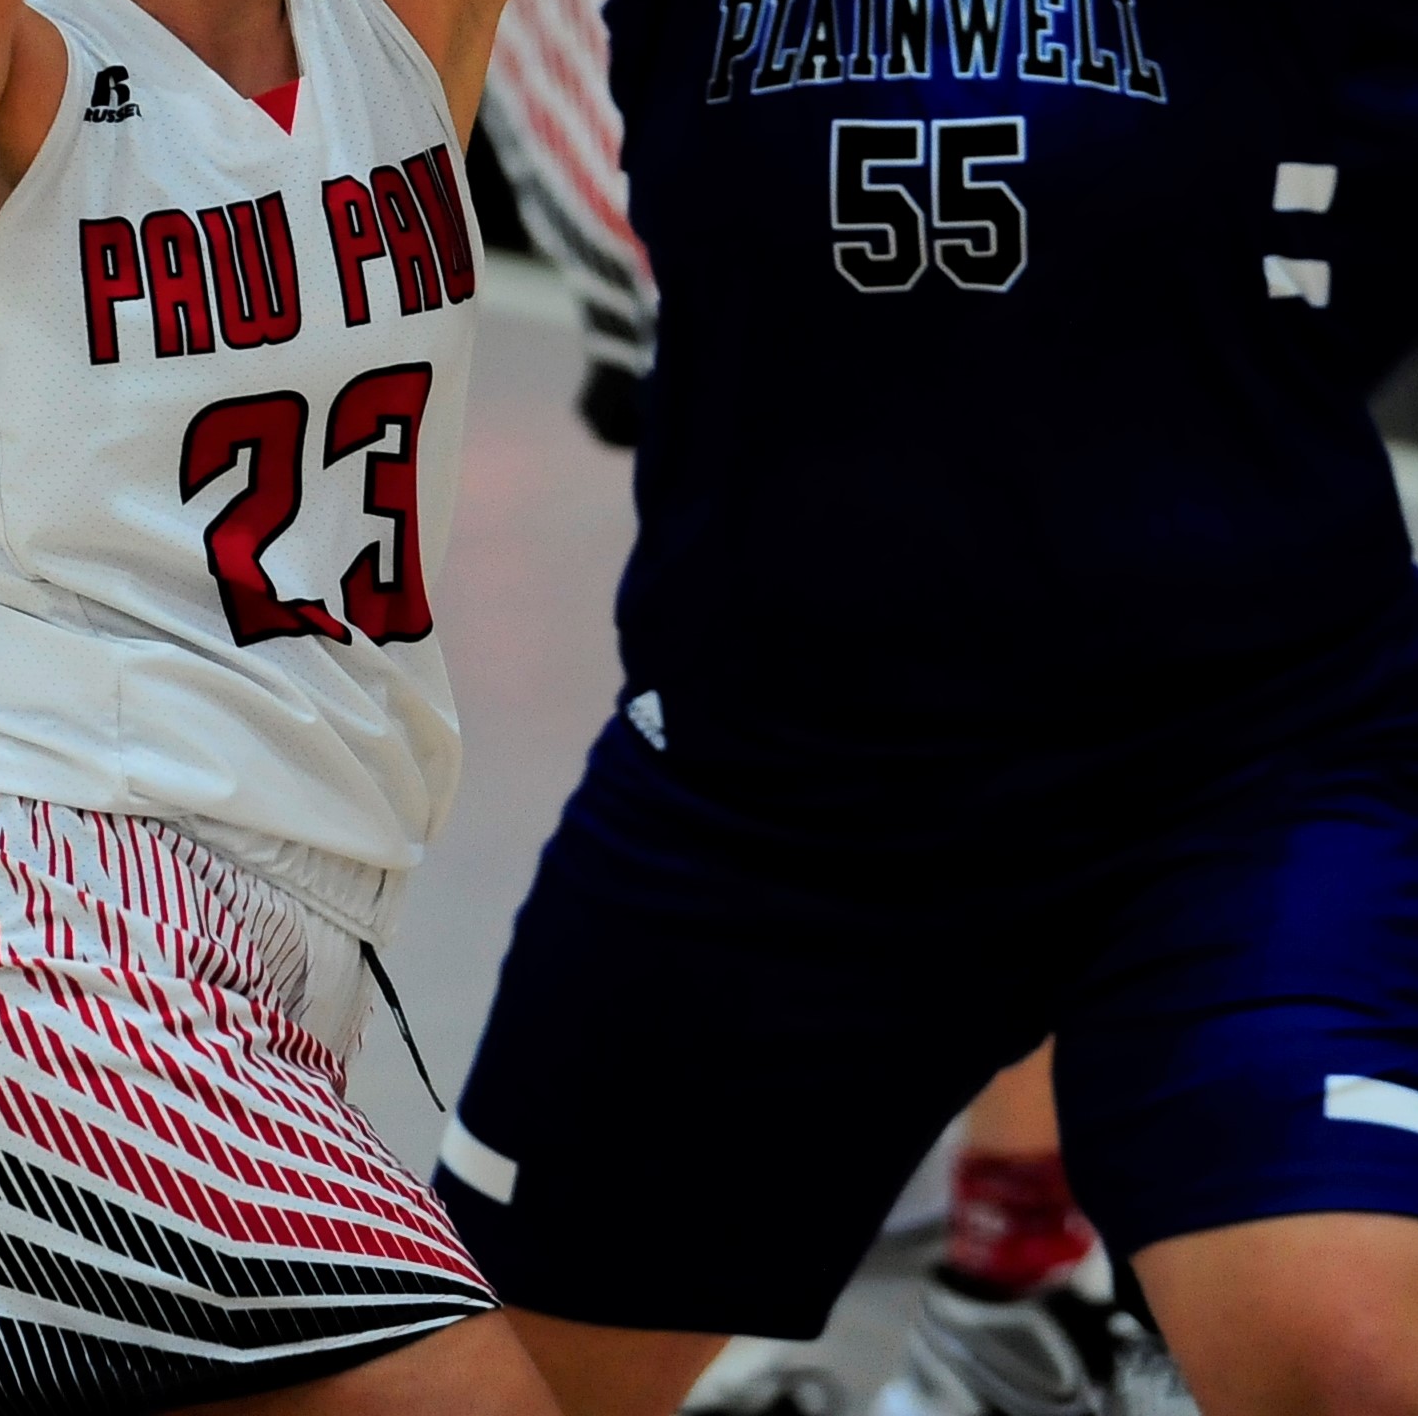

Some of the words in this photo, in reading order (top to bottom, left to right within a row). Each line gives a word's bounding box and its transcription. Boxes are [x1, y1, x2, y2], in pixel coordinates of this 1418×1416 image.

[79, 191, 301, 364] PAW
[322, 142, 475, 328] PAW
[830, 115, 1028, 294] 55
[179, 361, 433, 647] 23
